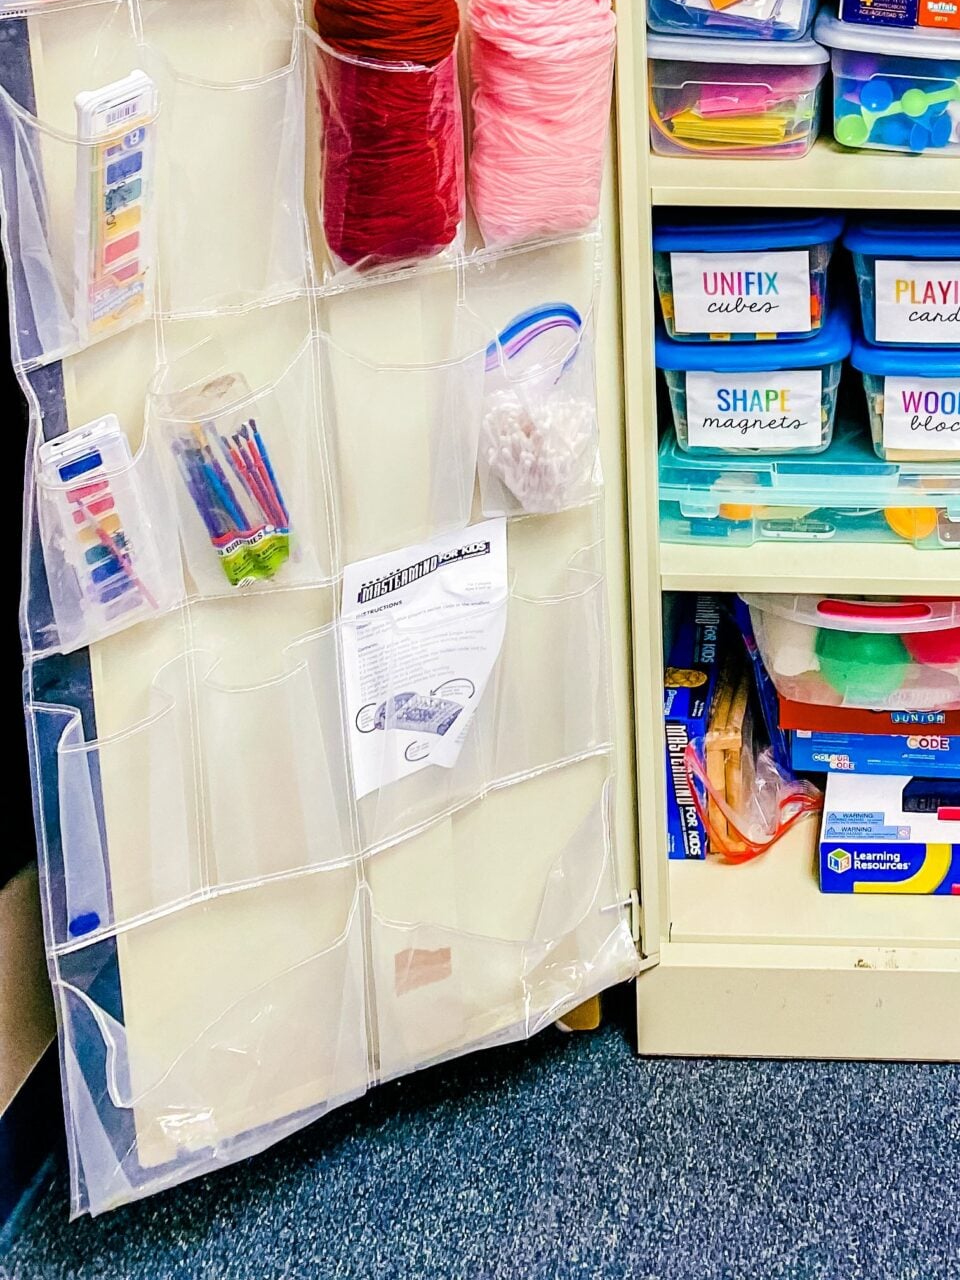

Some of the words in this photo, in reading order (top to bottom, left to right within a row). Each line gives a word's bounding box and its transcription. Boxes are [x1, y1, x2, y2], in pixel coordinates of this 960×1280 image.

[702, 271, 778, 296] UNIFIX
[706, 300, 780, 315] cubes
[717, 388, 791, 413] SHAPE
[702, 416, 808, 435] magnets
[461, 542, 487, 555] KIDS
[893, 713, 945, 724] JUNIOR
[907, 737, 949, 751] CODE
[685, 806, 698, 828] FOR
[688, 829, 702, 856] KIDS
[854, 851, 900, 863] Learning
[854, 861, 911, 870] Resources
